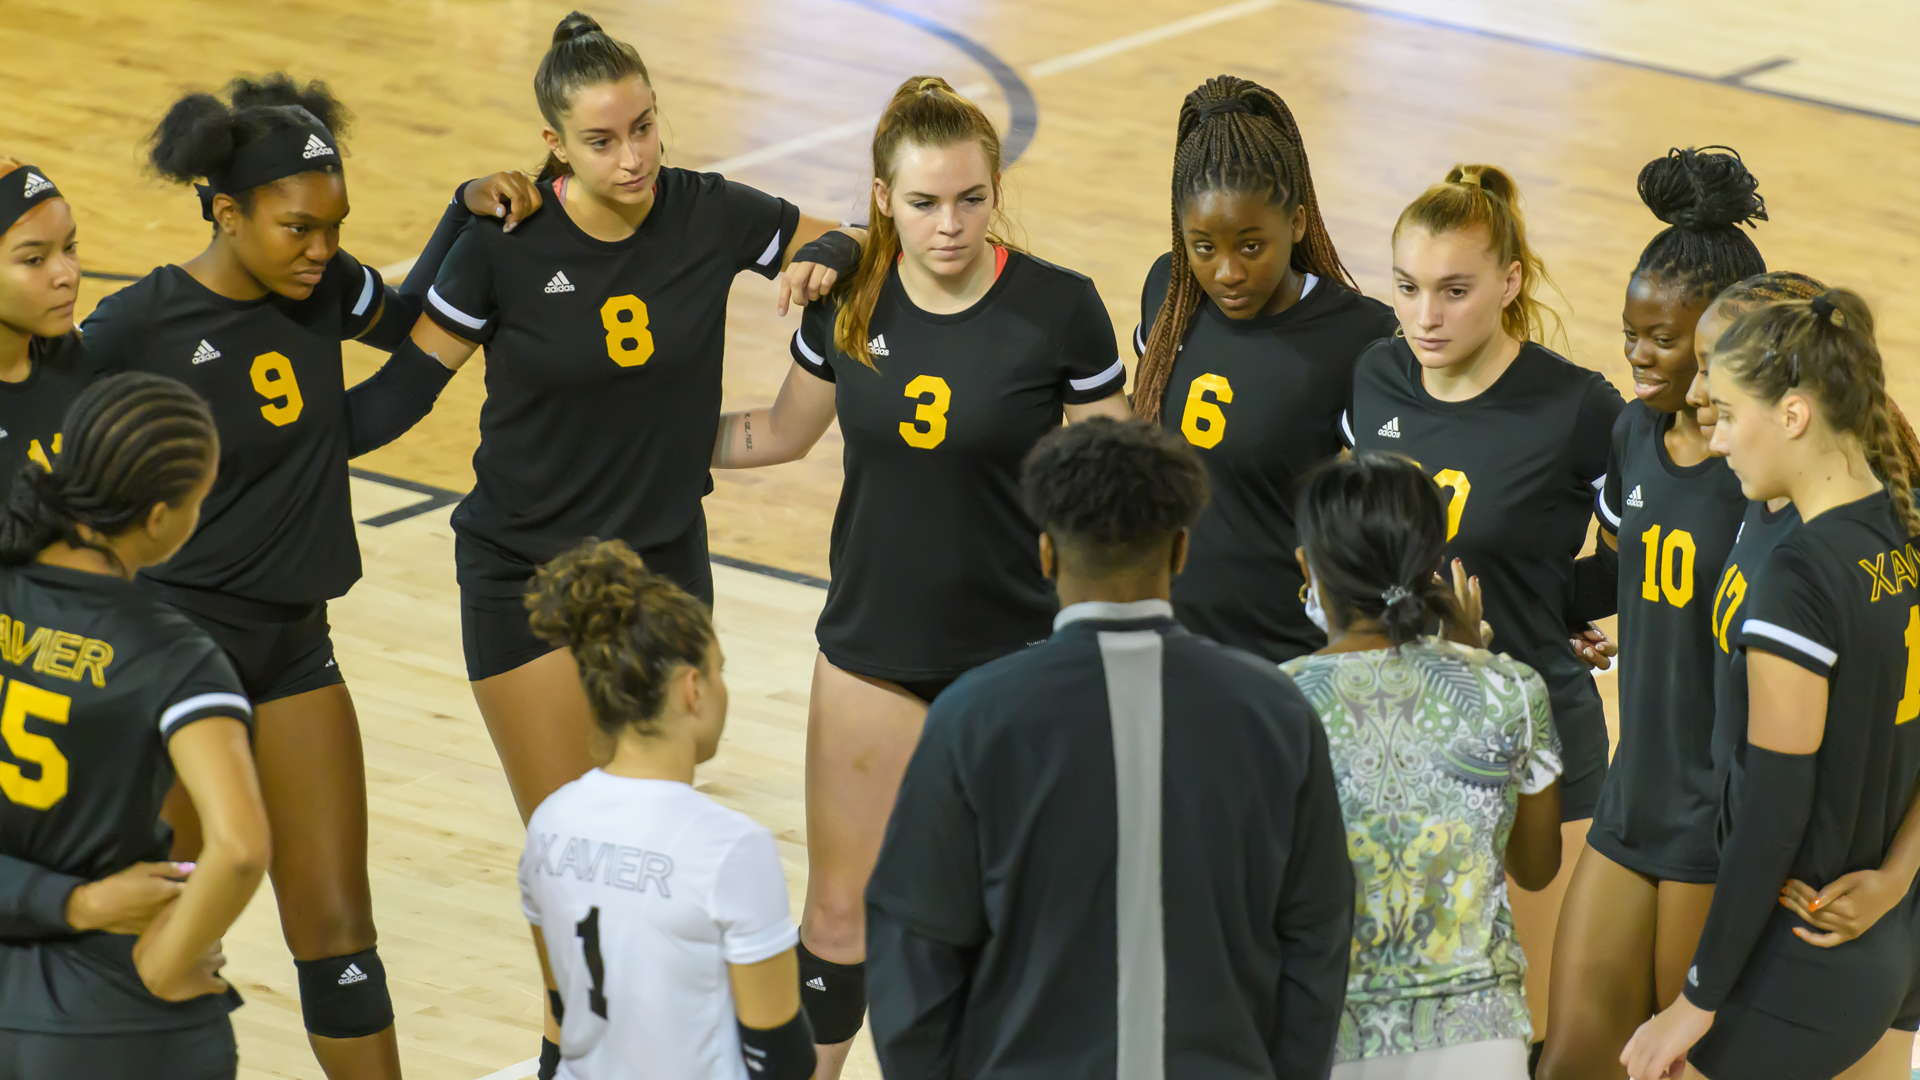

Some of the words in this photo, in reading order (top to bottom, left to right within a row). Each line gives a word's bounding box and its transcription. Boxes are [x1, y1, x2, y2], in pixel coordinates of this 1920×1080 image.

[302, 147, 335, 159] adidas
[23, 181, 54, 199] adidas
[544, 284, 576, 293] adidas
[192, 351, 221, 365] adidas
[600, 294, 655, 367] 8
[250, 351, 304, 427] 9
[899, 374, 951, 450] 3
[1181, 372, 1234, 449] 6
[1377, 428, 1401, 439] adidas
[1642, 524, 1696, 608] 10
[1712, 563, 1748, 654] 17
[0, 674, 72, 812] 5
[535, 832, 675, 898] XAVIER
[338, 973, 368, 985] adidas
[576, 905, 609, 1020] 1
